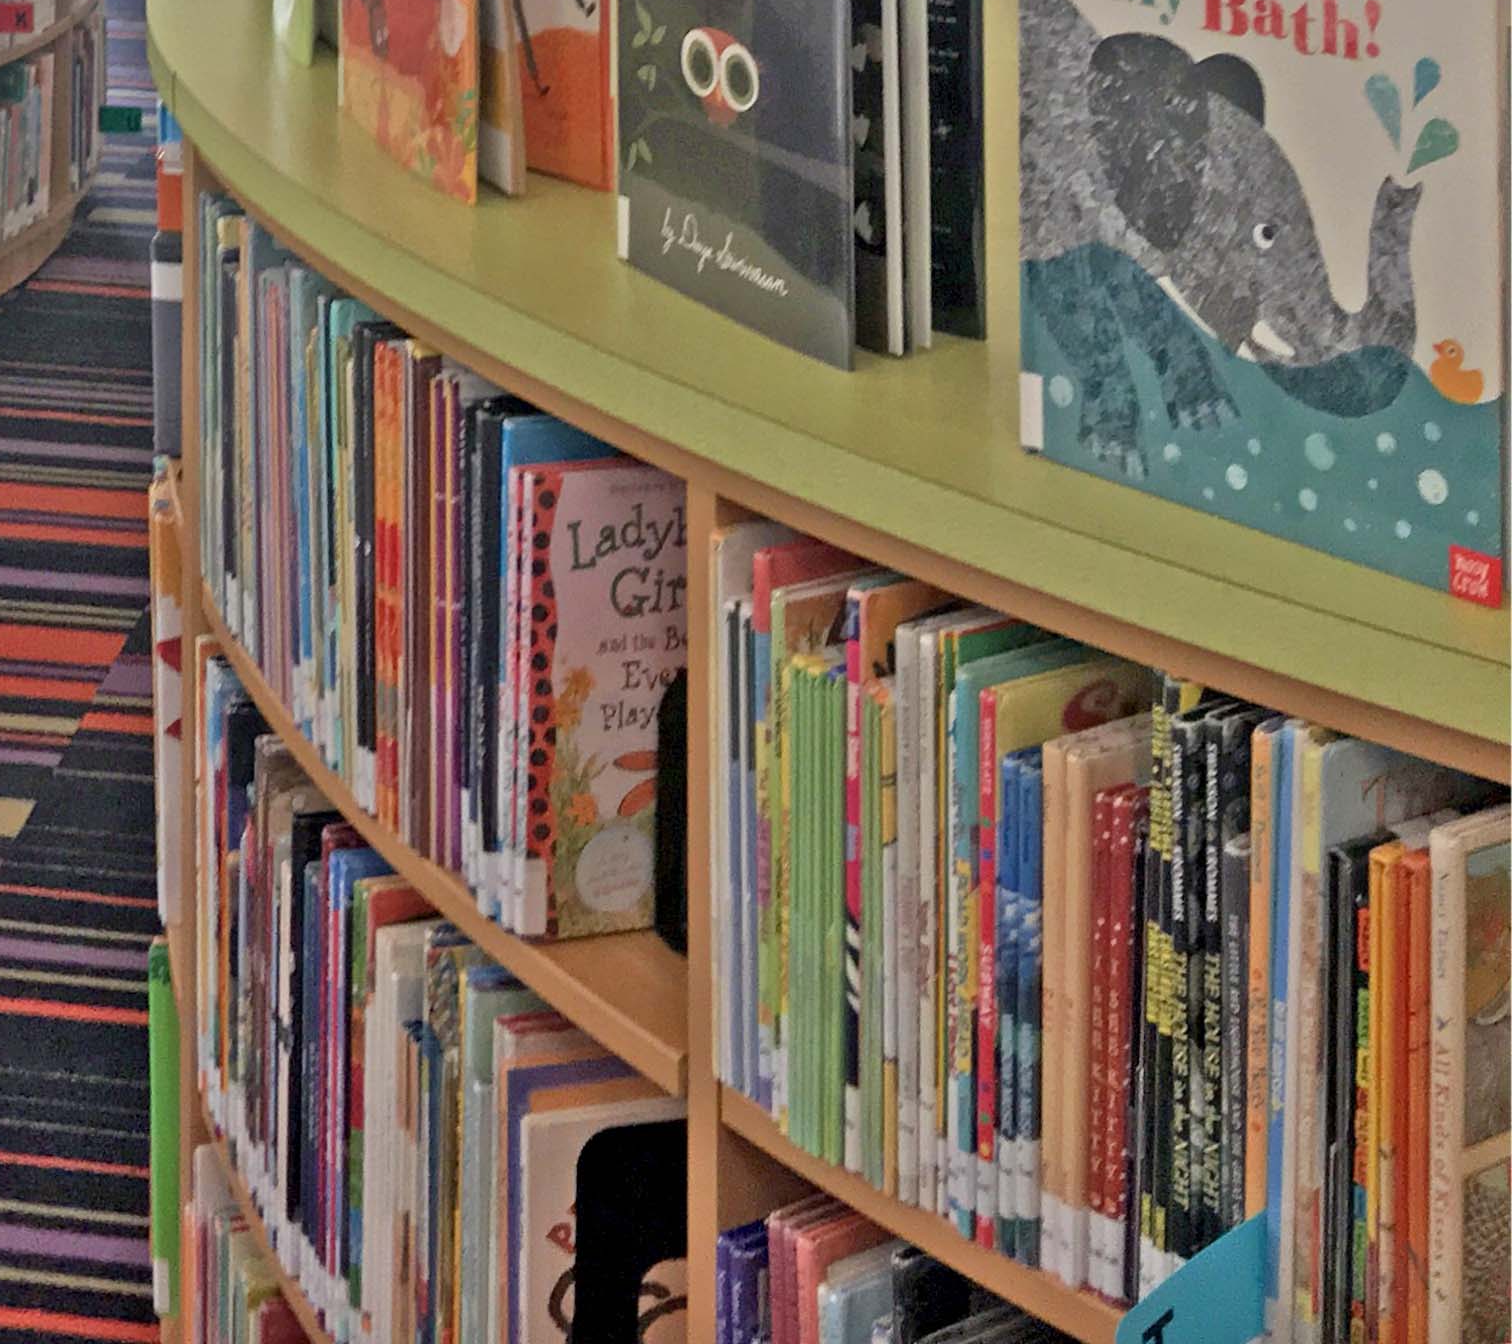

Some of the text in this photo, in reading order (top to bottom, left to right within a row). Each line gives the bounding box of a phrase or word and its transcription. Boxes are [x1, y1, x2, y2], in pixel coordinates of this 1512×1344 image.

[1173, 743, 1184, 820] SWANSON
[1206, 741, 1219, 821] SWANSON
[1172, 951, 1189, 997] THE
[1204, 952, 1221, 999] THE
[1172, 1000, 1188, 1077] HOUSE
[1204, 999, 1221, 1079] HOUSE
[1205, 1105, 1221, 1135] the
[1434, 1041, 1451, 1261] All Kinds of Kisses
[1172, 1136, 1189, 1211] NIGHT
[1203, 1138, 1221, 1213] NIGHT
